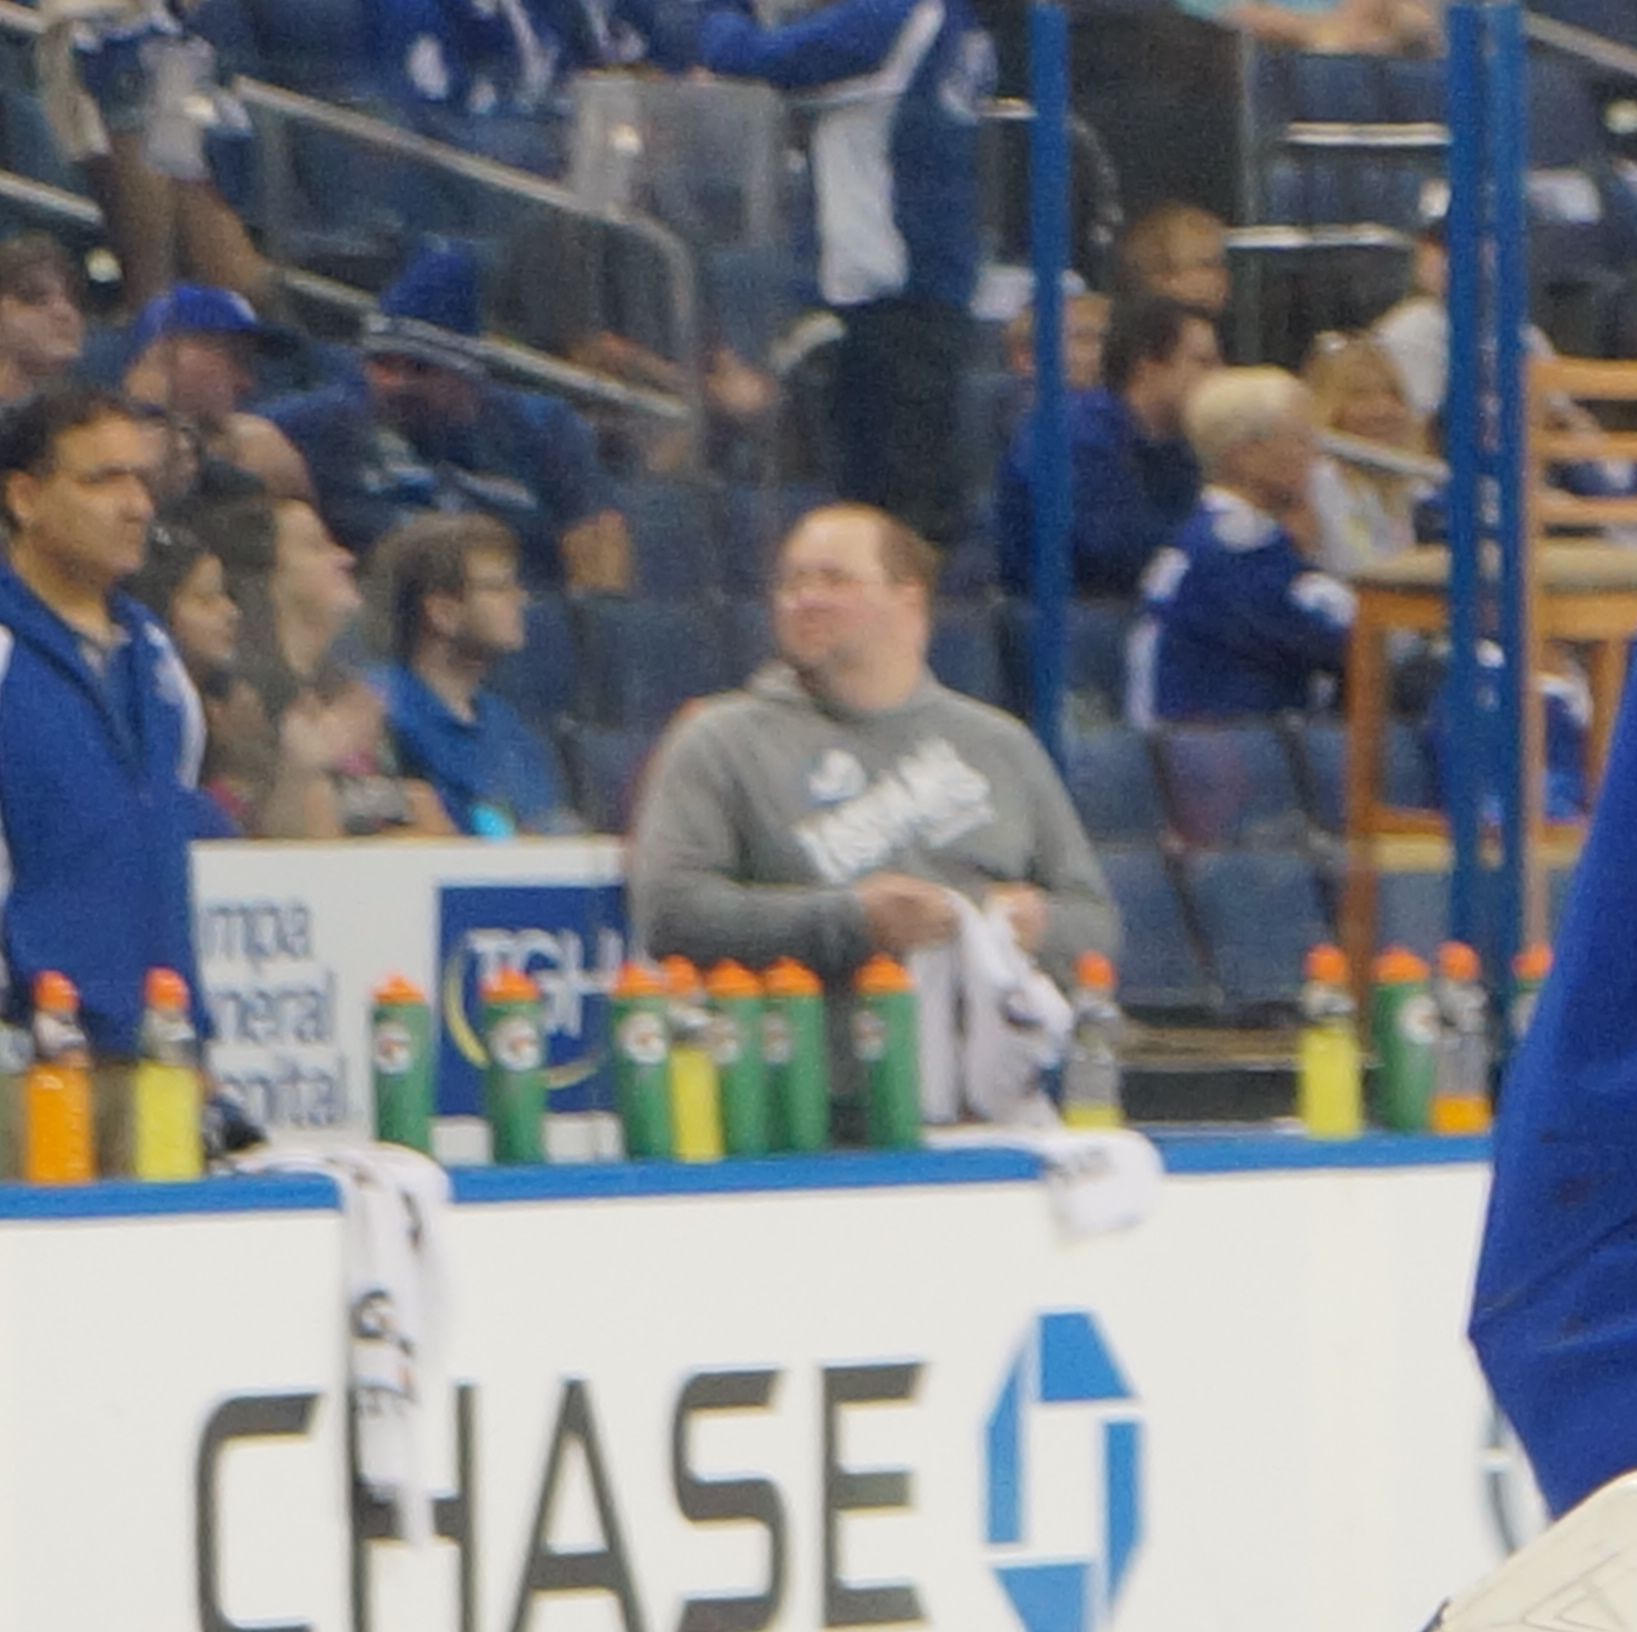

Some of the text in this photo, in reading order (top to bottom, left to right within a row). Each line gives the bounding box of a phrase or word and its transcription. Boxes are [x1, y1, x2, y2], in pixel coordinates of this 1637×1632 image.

[202, 901, 313, 976] mpa
[211, 968, 337, 1044] neral
[199, 1360, 930, 1632] CHASE
